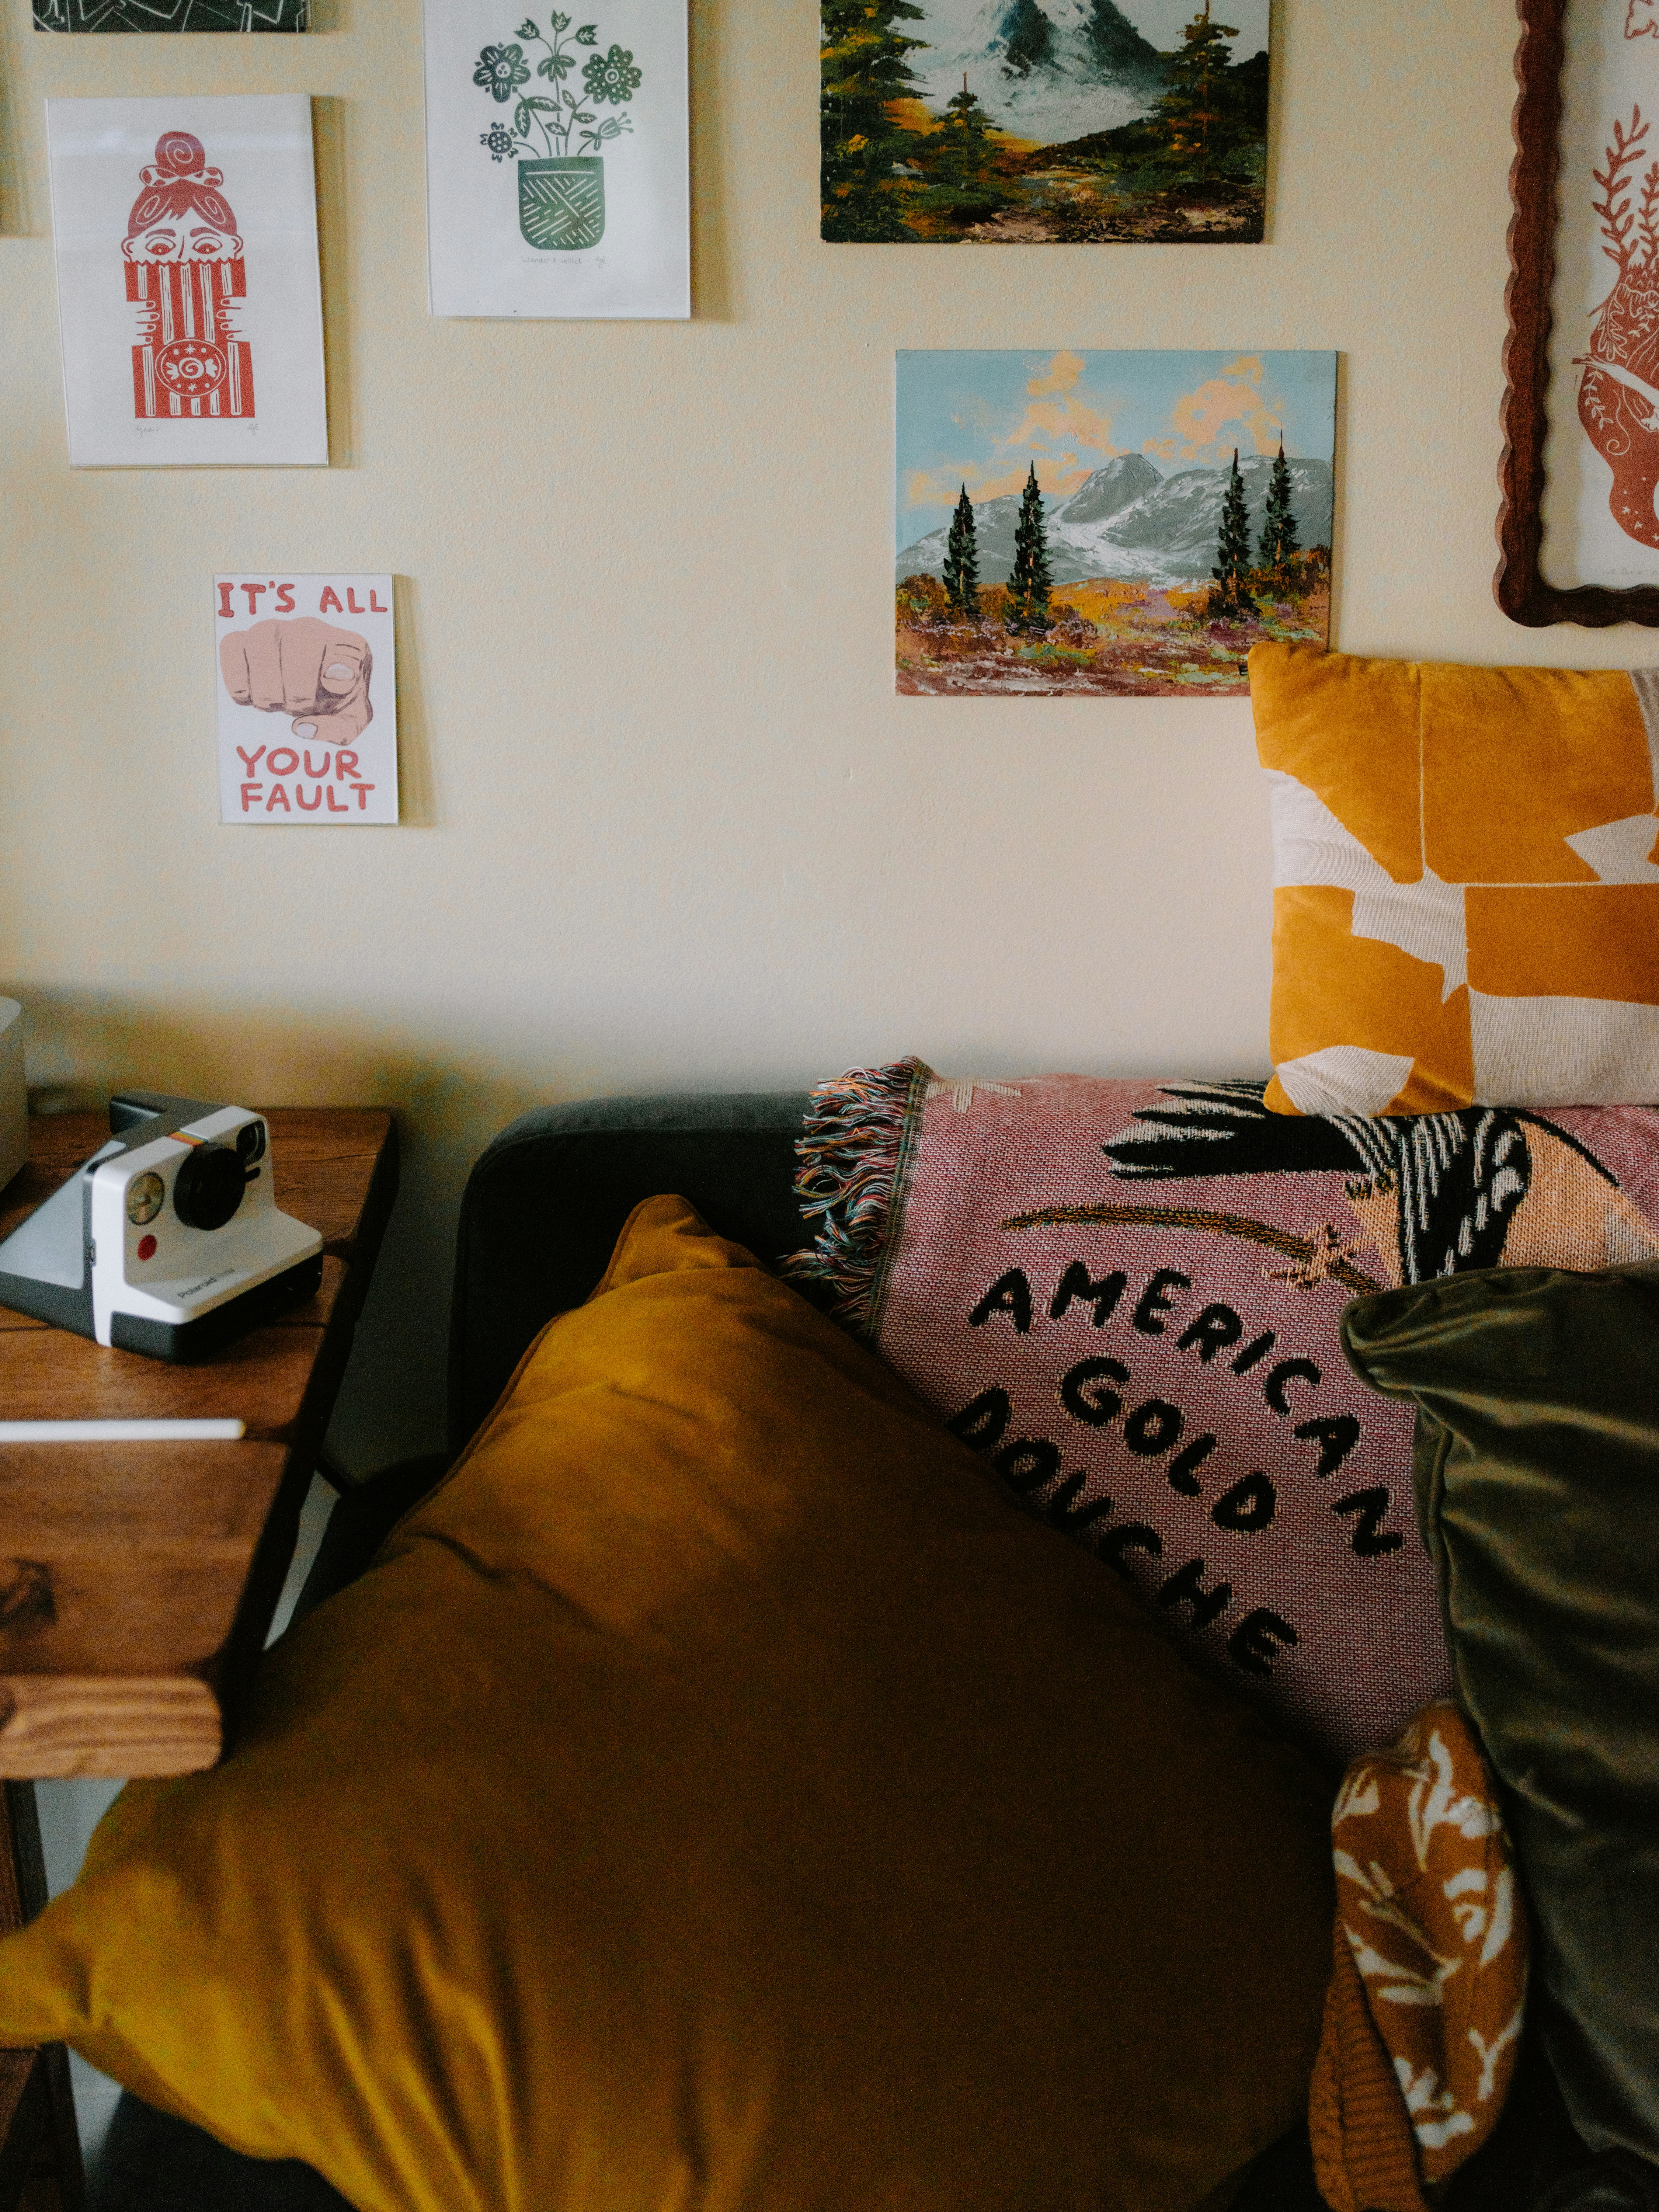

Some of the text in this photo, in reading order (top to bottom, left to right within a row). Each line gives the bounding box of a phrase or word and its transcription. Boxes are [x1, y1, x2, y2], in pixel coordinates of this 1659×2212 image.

[218, 581, 388, 618] IT'S ALL
[236, 745, 362, 780] YOUR
[240, 783, 375, 812] FAULT
[968, 1259, 1404, 1557] AMERICAN
[1060, 1355, 1278, 1533] GOLD
[945, 1387, 1299, 1676] DOUCHE
